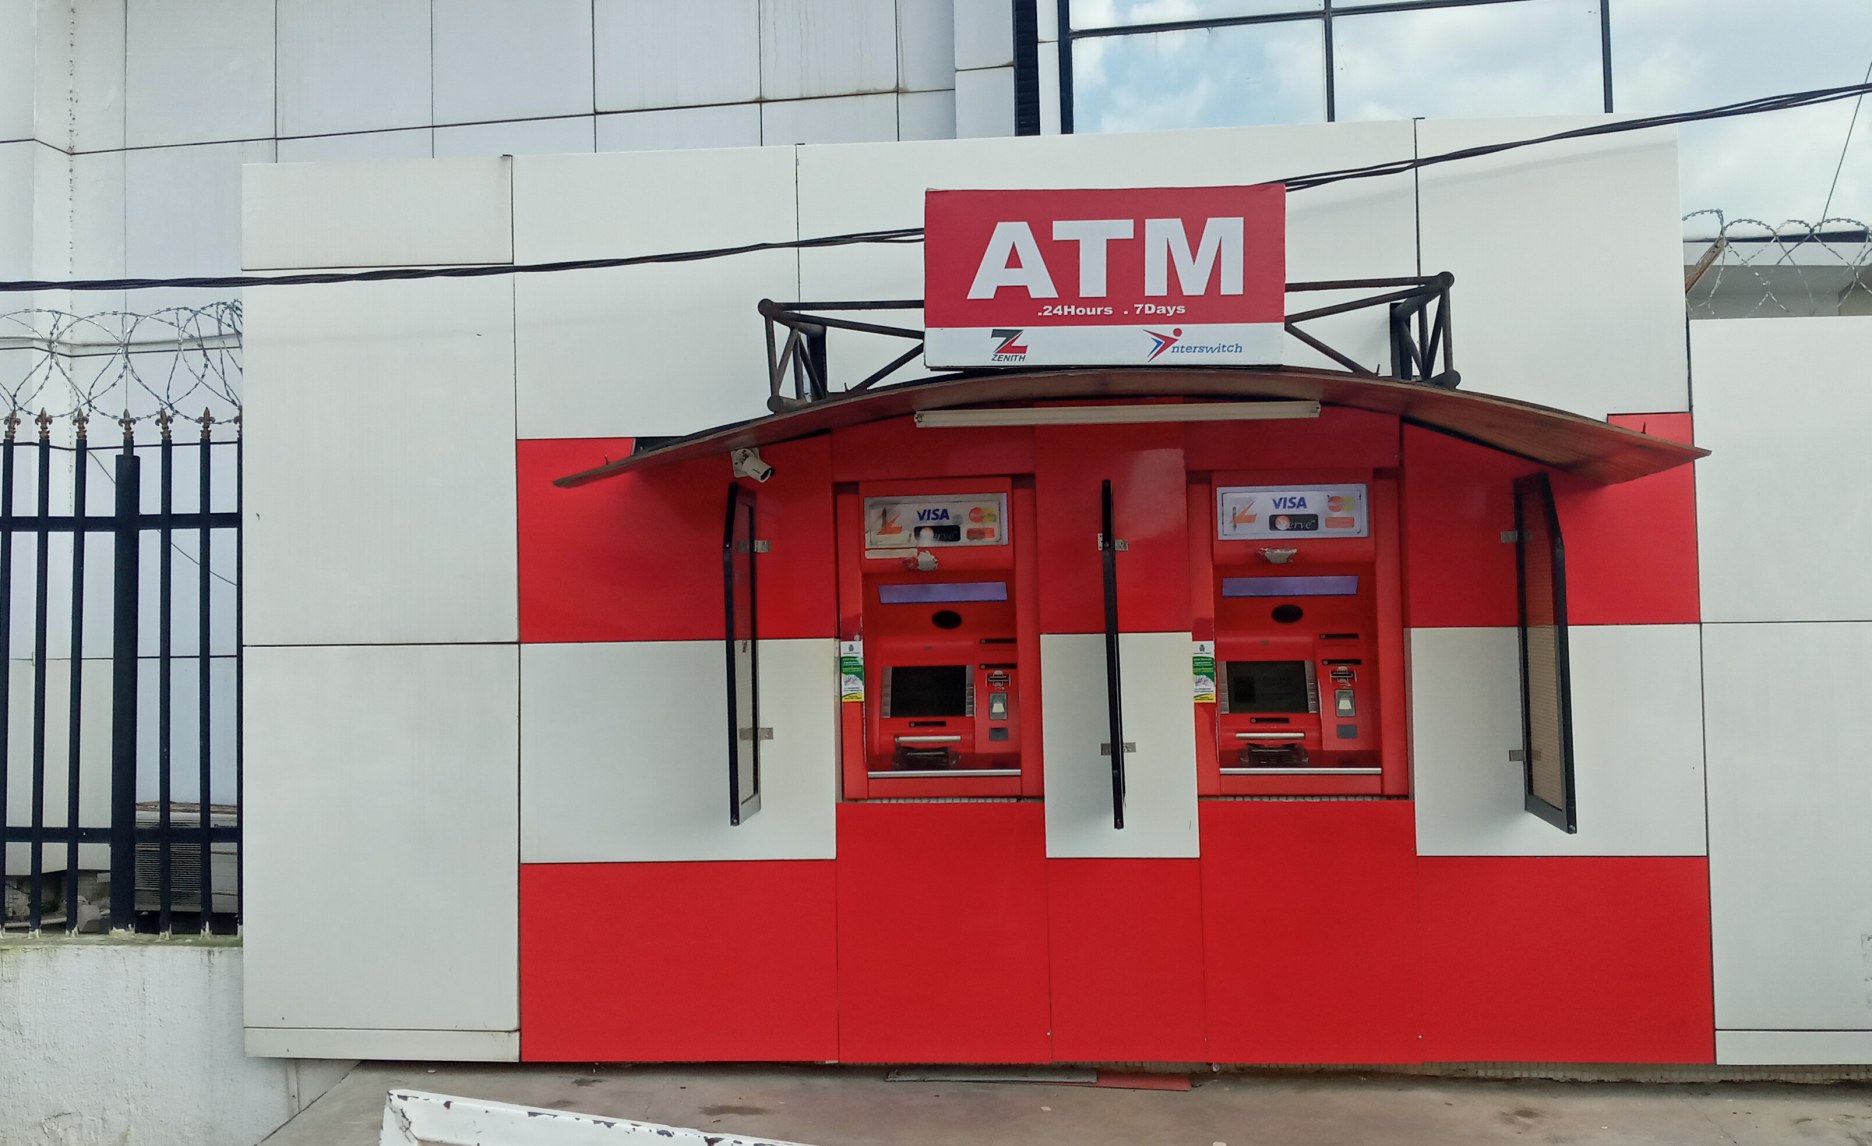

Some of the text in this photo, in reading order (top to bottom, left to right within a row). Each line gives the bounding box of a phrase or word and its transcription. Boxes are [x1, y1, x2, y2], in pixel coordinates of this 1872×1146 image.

[966, 217, 1244, 300] ATM
[991, 353, 1027, 362] ZENITH
[1272, 497, 1307, 509] VISA
[917, 508, 950, 520] VISA
